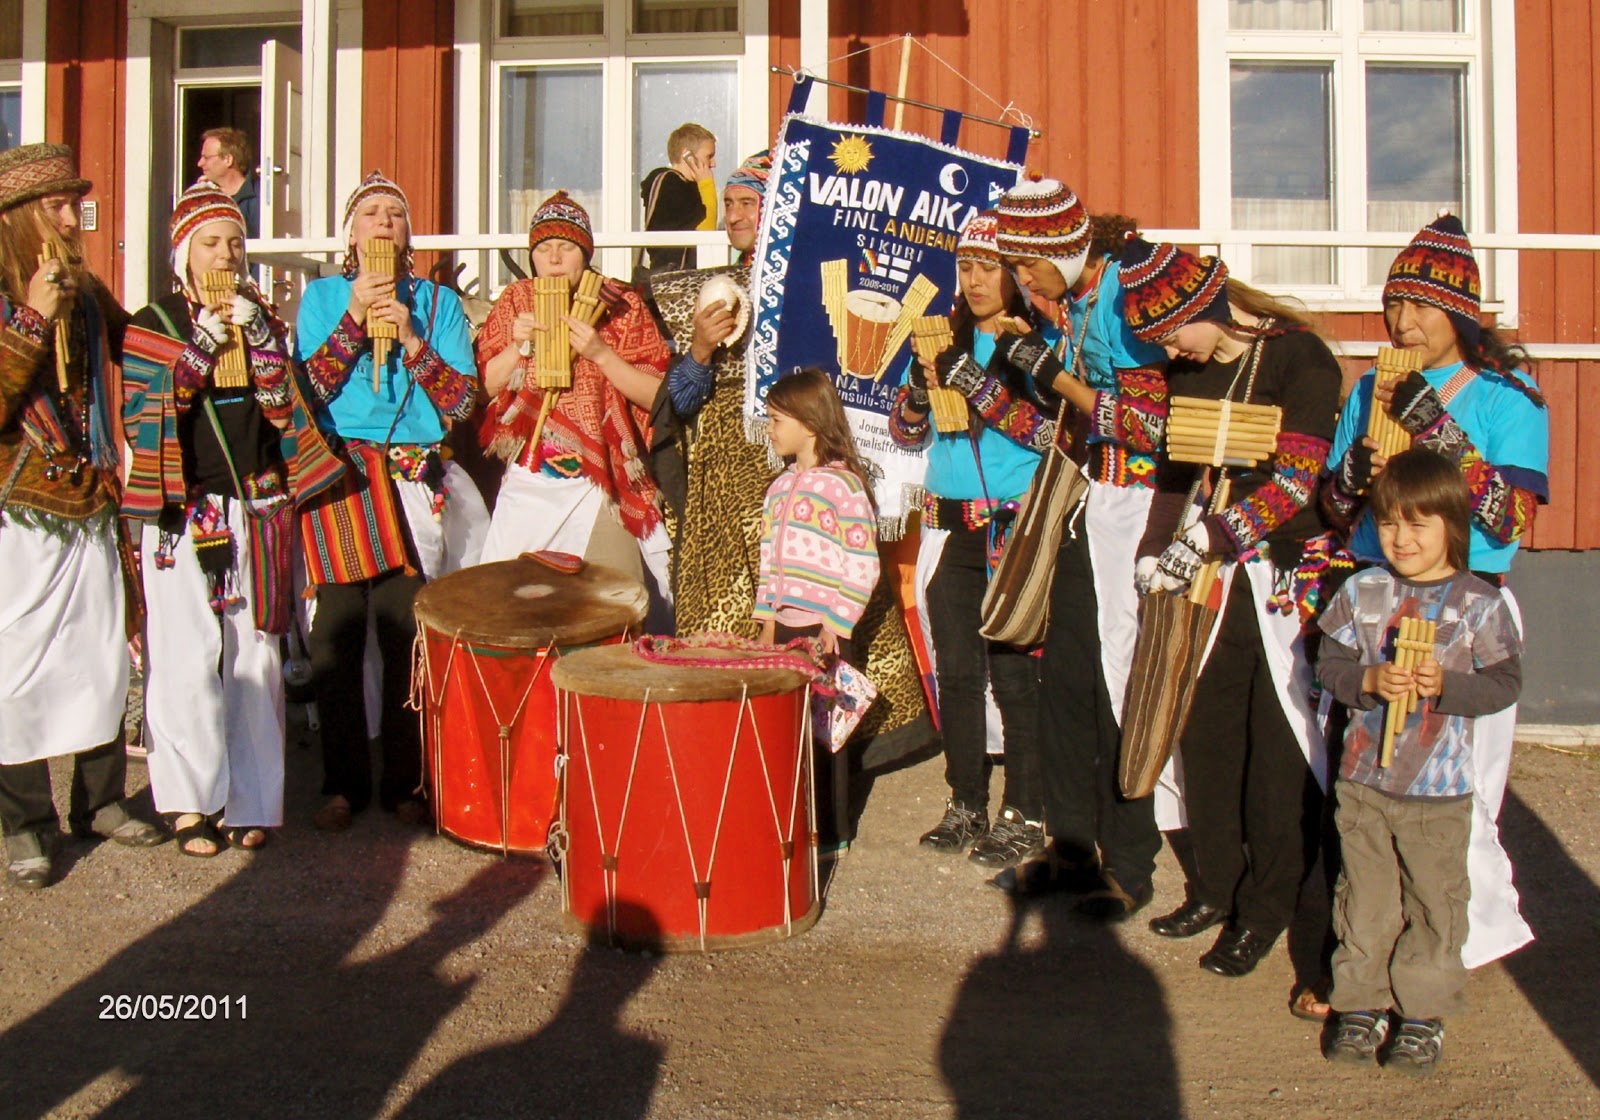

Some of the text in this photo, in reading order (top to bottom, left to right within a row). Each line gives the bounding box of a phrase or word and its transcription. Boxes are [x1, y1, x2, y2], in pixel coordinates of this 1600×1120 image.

[809, 172, 904, 217] VALON
[856, 234, 923, 263] SIKURI
[869, 382, 899, 402] PAC
